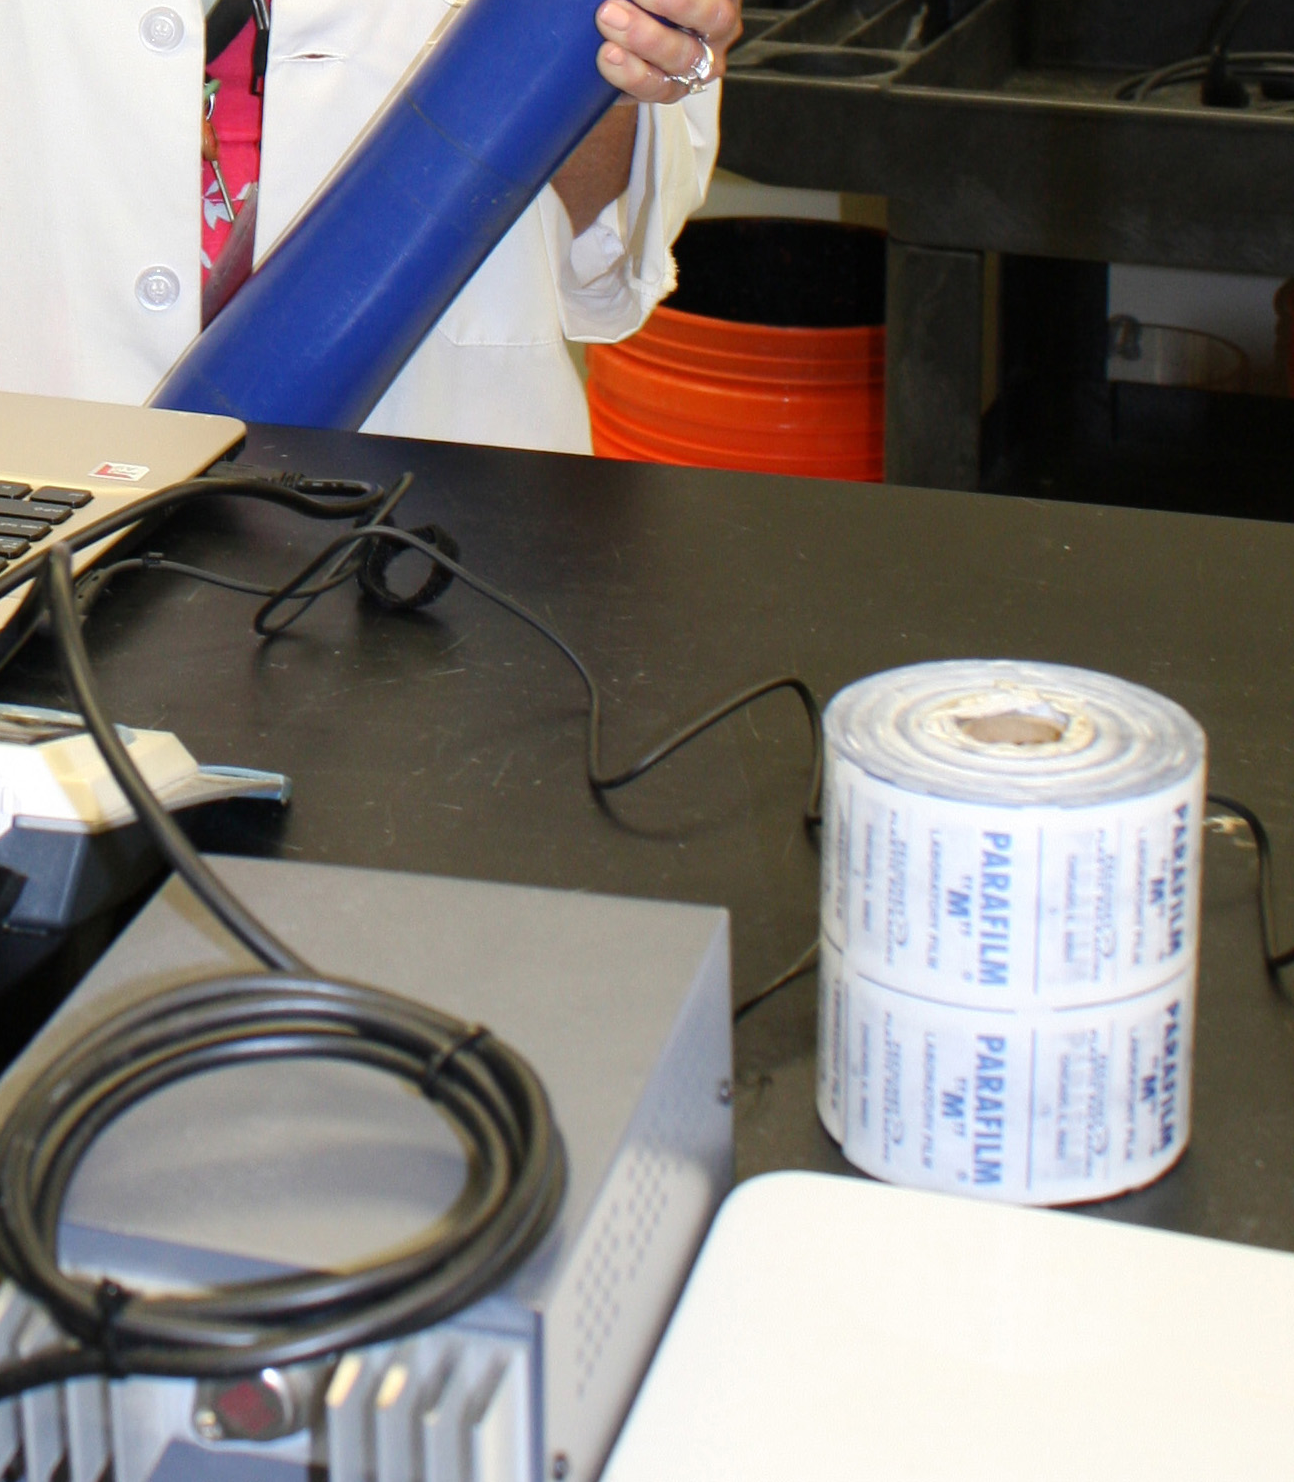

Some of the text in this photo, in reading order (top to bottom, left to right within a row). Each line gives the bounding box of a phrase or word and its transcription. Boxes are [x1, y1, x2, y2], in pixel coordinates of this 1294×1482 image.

[979, 831, 1012, 985] PARAFILM
[1167, 802, 1188, 957] PARAFILM
[974, 1034, 1006, 1185] PARAFILM
[1160, 999, 1180, 1152] PARAFILM
